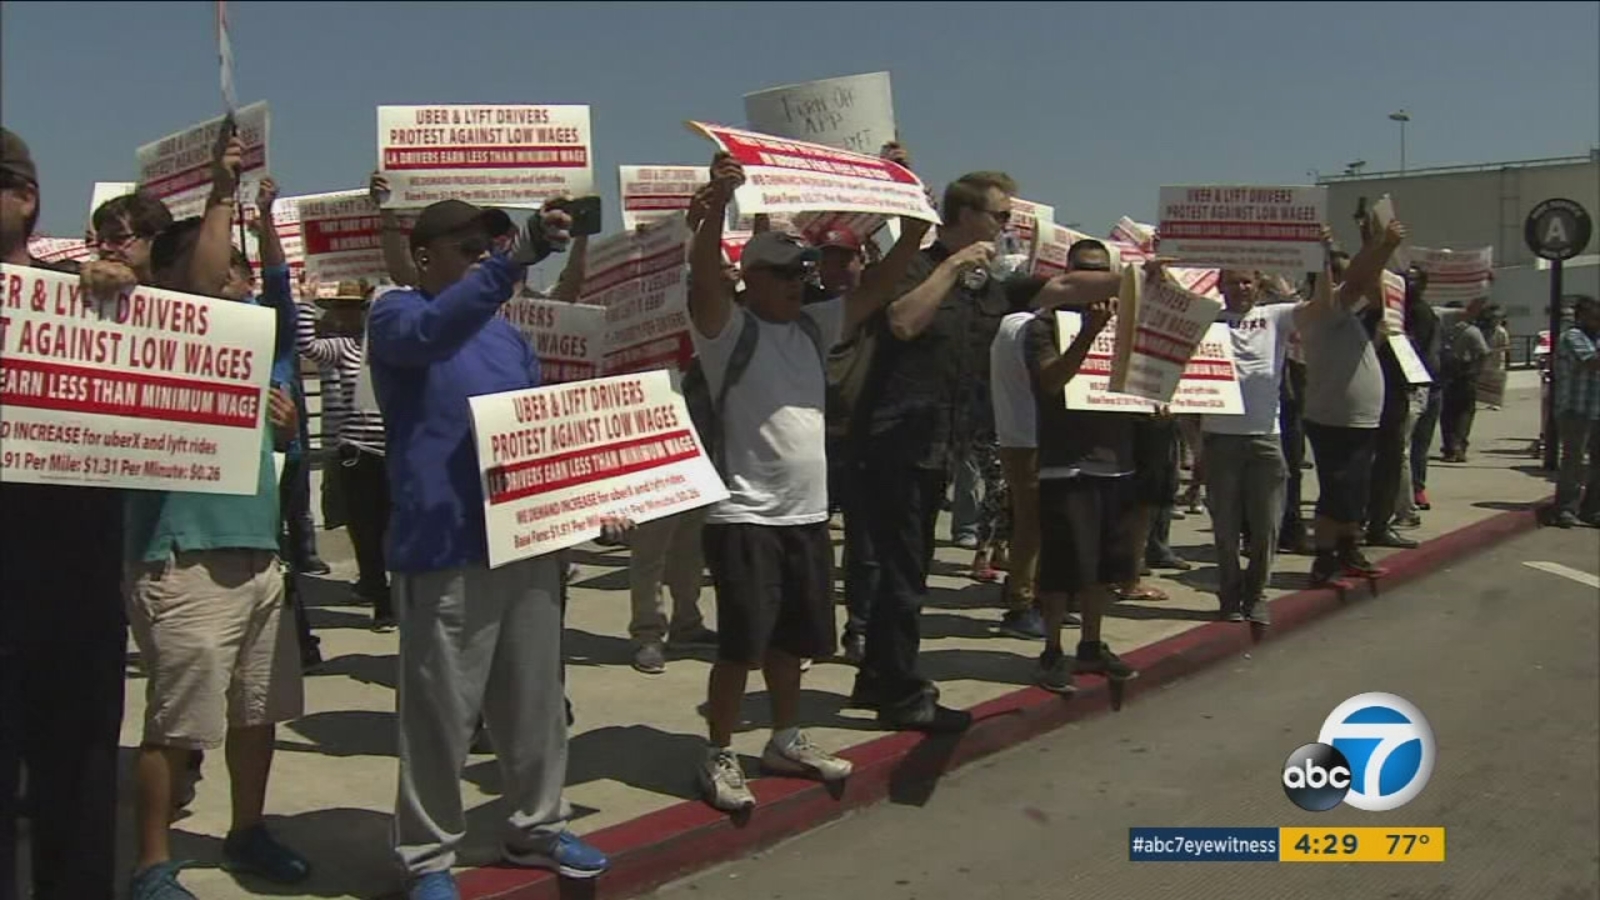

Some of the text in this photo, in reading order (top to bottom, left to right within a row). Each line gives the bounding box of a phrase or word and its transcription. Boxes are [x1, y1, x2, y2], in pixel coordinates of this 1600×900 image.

[416, 108, 550, 125] UBER & LYFT DRIVERS
[390, 127, 579, 144] PROTEST AGAINST LOW WAGES
[1545, 217, 1567, 242] A
[30, 278, 47, 313] &
[115, 292, 209, 336] DRIVERS
[505, 300, 555, 328] RIVERS
[18, 320, 122, 366] AGAINST
[129, 335, 178, 371] LOW
[184, 342, 254, 380] WAGES
[536, 332, 587, 358] WAGES
[48, 374, 87, 401] LESS
[92, 379, 137, 407] THAN
[141, 385, 214, 414] MINIMUM
[217, 391, 257, 418] WAGE
[514, 380, 645, 424] UBER & LYFT DRIVERS
[14, 421, 81, 445] INCREASE
[82, 427, 102, 446] for
[104, 430, 141, 449] uberX
[142, 433, 166, 450] and
[166, 434, 188, 455] lyft
[189, 439, 218, 455] rides
[491, 404, 679, 462] PROTEST AGAINST LOW WAGES
[24, 452, 46, 470] Per
[83, 455, 119, 475] $1.31
[120, 459, 142, 476] Per
[570, 456, 592, 476] LESS
[592, 450, 620, 473] THAN
